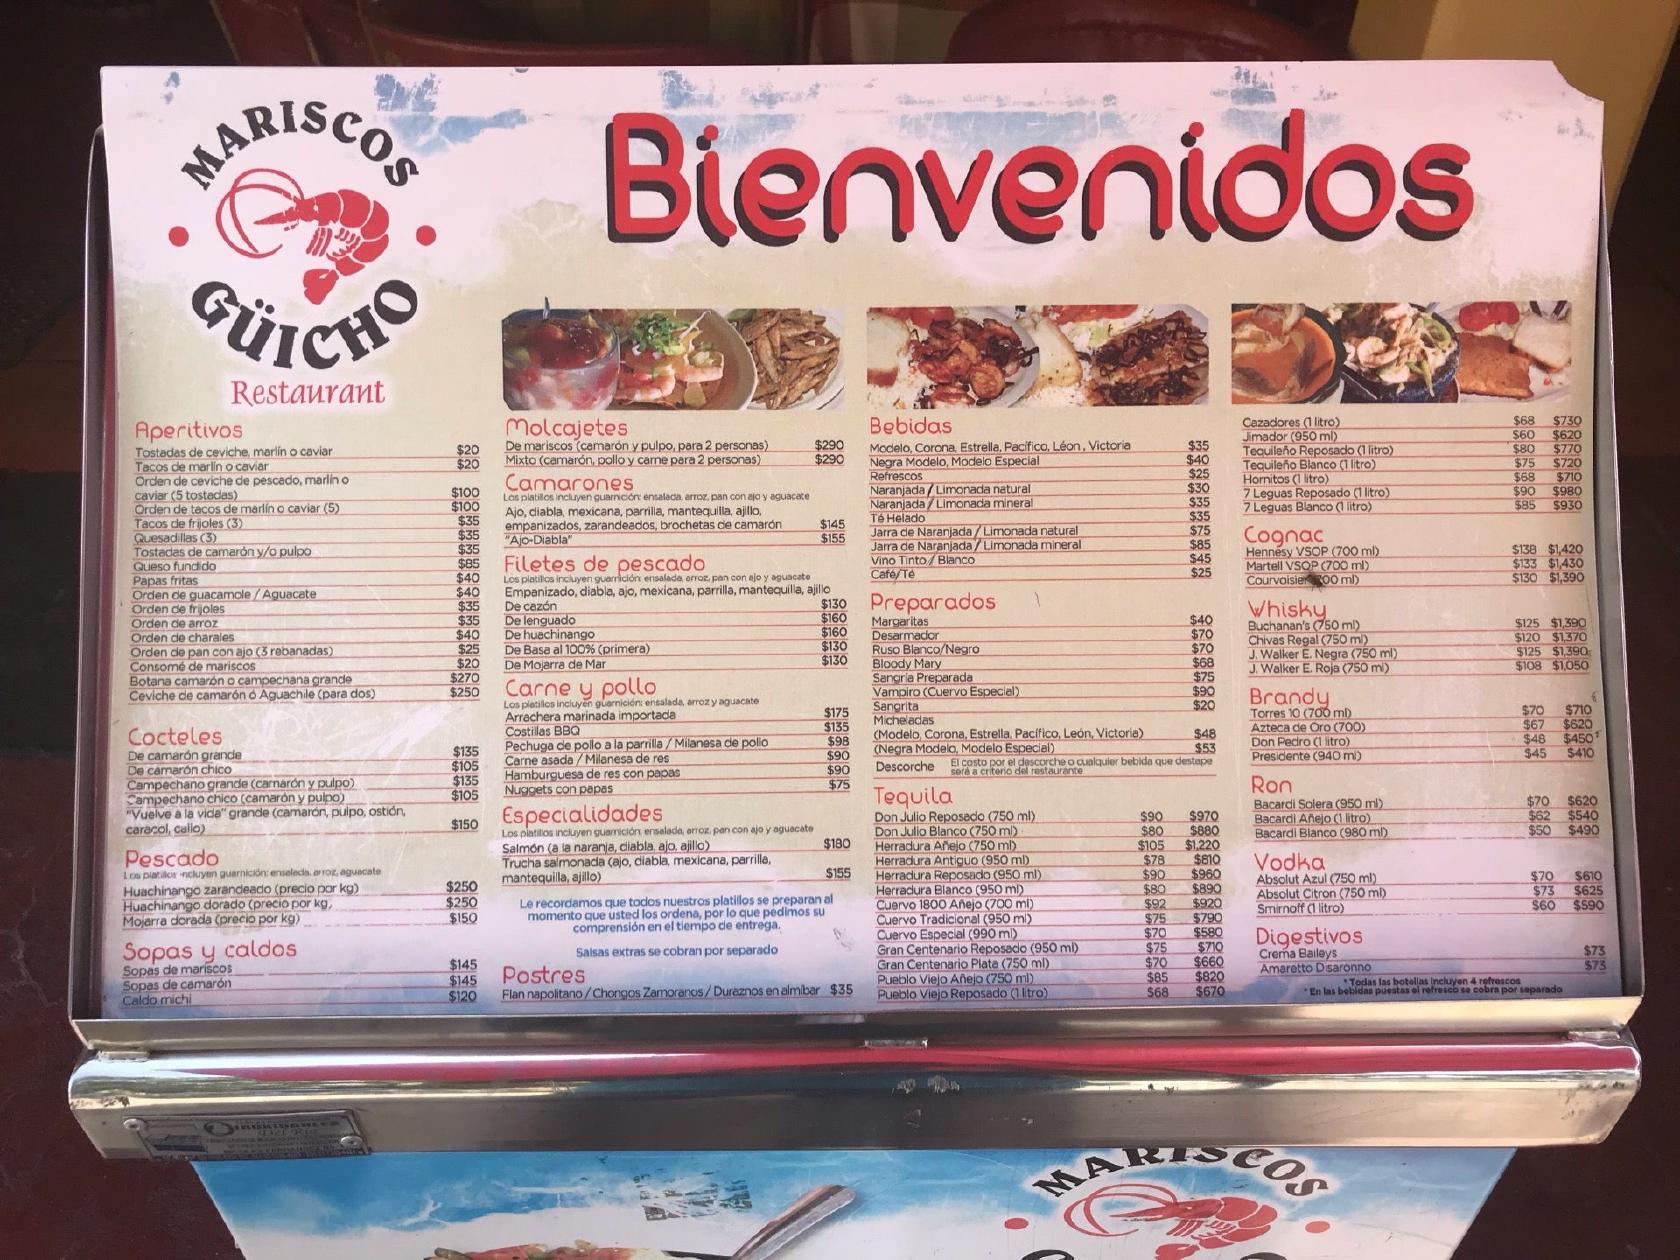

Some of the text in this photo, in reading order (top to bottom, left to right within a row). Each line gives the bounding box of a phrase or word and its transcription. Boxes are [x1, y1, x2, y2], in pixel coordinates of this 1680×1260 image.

[181, 101, 419, 190] MARISCOS
[606, 109, 1472, 243] Bienvenidos
[192, 279, 418, 369] GÜICHO
[231, 380, 385, 407] Restaurant
[135, 421, 242, 441] Aperitivos
[507, 418, 628, 441] Molcajetes
[870, 417, 952, 434] Bebidas
[1242, 429, 1582, 442] Jimador (950 ml) $60 $620
[136, 444, 479, 459] Tostadas de ceviche, marlín o caviar $20
[505, 453, 844, 467] Mixto (camarón, pollo y carne para 2 personas) $290
[505, 474, 633, 491] Camarones
[870, 468, 1209, 481] Refrescos $25
[871, 511, 1210, 523] Té Helado $35
[505, 533, 845, 547] "Ajo-Diabla" $155
[1244, 526, 1323, 548] Cognac
[134, 558, 479, 573] Queso fundido $85
[505, 554, 705, 576] Filetes de pescado
[133, 572, 479, 588] Papas fritas $40
[871, 567, 1211, 580] Café/Té $25
[871, 592, 996, 613] Preparados
[1248, 600, 1327, 621] Whisky
[132, 614, 479, 629] Orden de arroz $35
[505, 613, 847, 628] De lenguado $160
[872, 615, 1213, 628] Margaritas $40
[505, 626, 847, 641] De huachinango $160
[872, 629, 1213, 641] Desarmador $70
[1248, 631, 1587, 646] Chivas Regal (750 ml) $120 $1,370
[130, 657, 479, 672] Consomé de mariscos $20
[873, 657, 1214, 670] Bloody Mary $68
[130, 688, 174, 702] Ceviche
[176, 688, 192, 702] de
[196, 688, 246, 701] camarón
[259, 687, 314, 701] Aguachile
[317, 688, 348, 700] (para
[351, 688, 375, 700] dos)
[451, 686, 479, 699] $250
[506, 678, 656, 701] Carne y pollo
[1250, 688, 1329, 709] Brandy
[873, 715, 934, 726] Micheladas
[128, 727, 222, 745] Cocteles
[505, 722, 849, 737] Costillas BBQ $135
[1252, 747, 1594, 762] Presidente (940 ml) $45 $410
[128, 762, 479, 776] De camarón chico $105
[876, 761, 934, 772] Descorche
[505, 779, 850, 796] Nuggets con papas $75
[1252, 776, 1292, 793] Ron
[874, 786, 953, 808] Tequila
[502, 805, 663, 828] Especialidades
[875, 810, 1218, 823] Don Julio Reposado (750 ml) $90 $970
[125, 849, 219, 868] Pescado
[1254, 853, 1325, 871] Vodka
[1258, 902, 1305, 914] Smirnoff
[1532, 900, 1555, 912] $60
[1573, 900, 1604, 911] $590
[1256, 928, 1362, 949] Digestivos
[123, 940, 297, 963] Sopas y caldos
[576, 945, 778, 957] Salsas extras se cobran por separado
[123, 959, 477, 976] Sopas de mariscos $145
[503, 965, 585, 985] Postres
